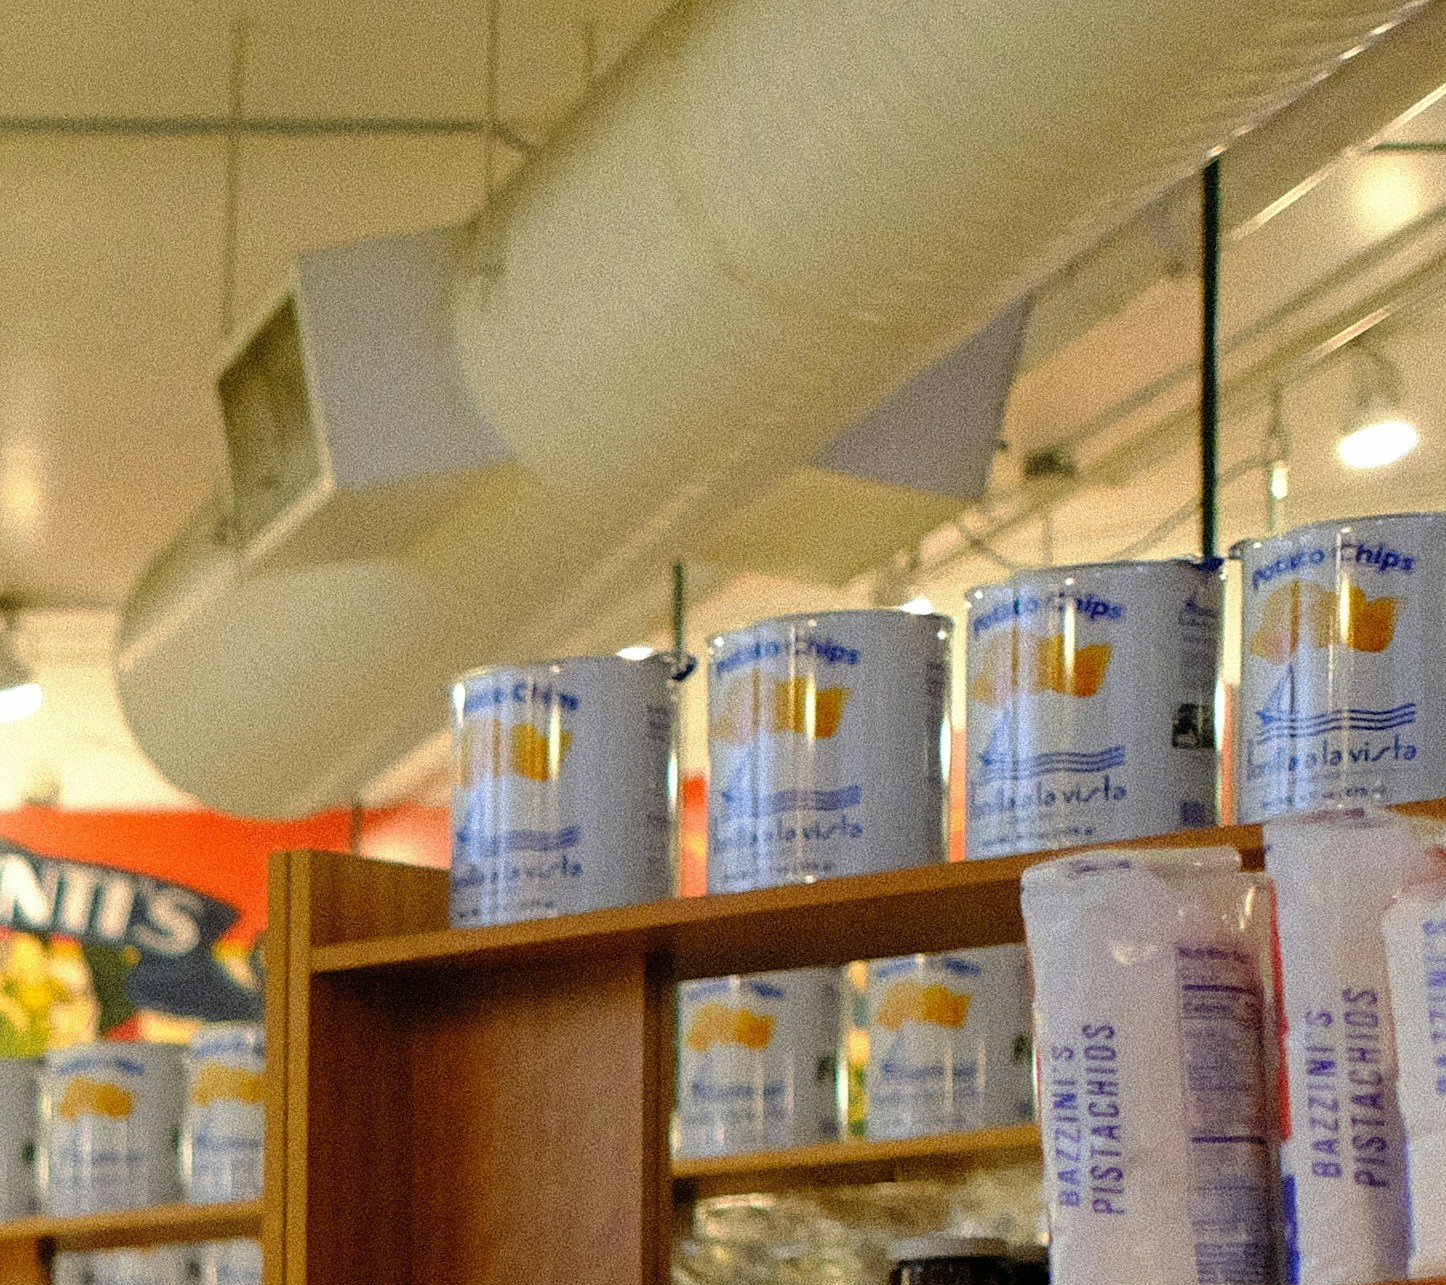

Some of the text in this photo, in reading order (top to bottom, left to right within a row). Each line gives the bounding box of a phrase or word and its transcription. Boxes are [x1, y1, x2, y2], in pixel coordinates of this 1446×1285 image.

[1050, 1043, 1085, 1208] BAZZINI'S
[1081, 1021, 1127, 1218] PISTACHIOS
[1304, 1008, 1344, 1181] BAZZINI'S
[1342, 985, 1392, 1190] PISTACHIOS
